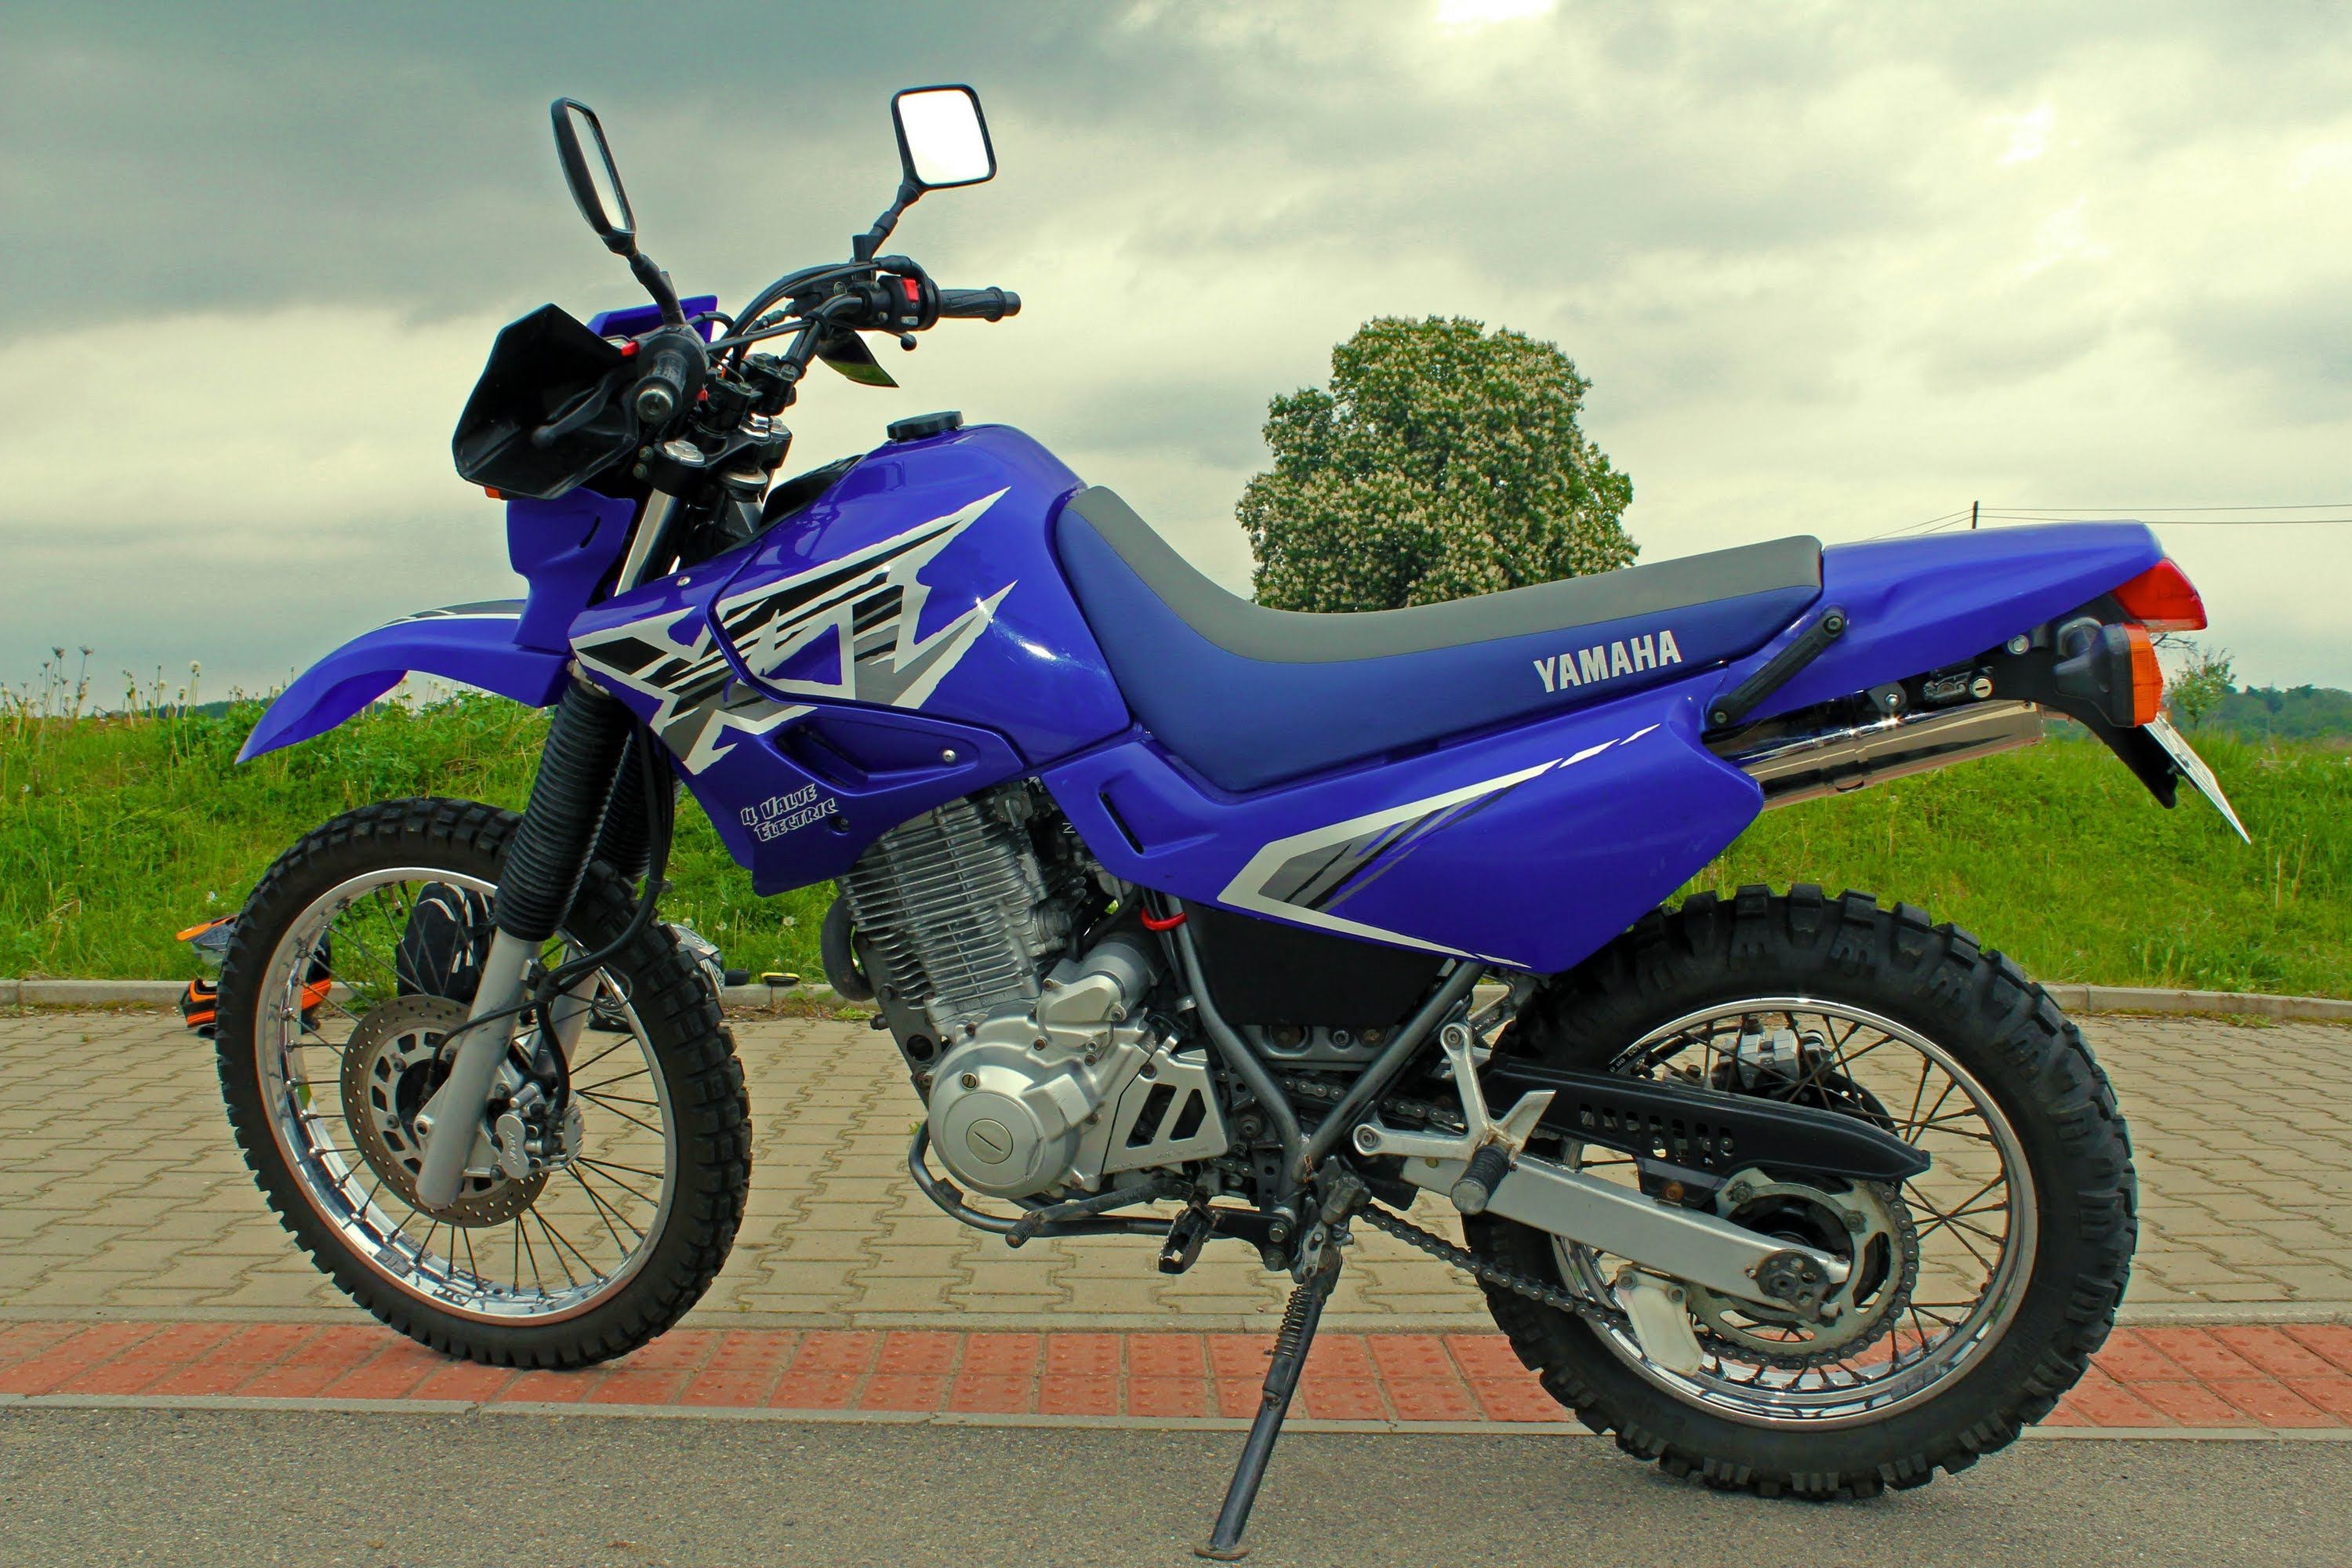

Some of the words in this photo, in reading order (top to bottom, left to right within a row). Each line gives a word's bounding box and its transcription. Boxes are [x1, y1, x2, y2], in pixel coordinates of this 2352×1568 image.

[1534, 630, 1682, 693] YAMAHA
[741, 807, 758, 826] 4
[760, 783, 817, 819] VALVE
[754, 797, 839, 841] ELECTRIC
